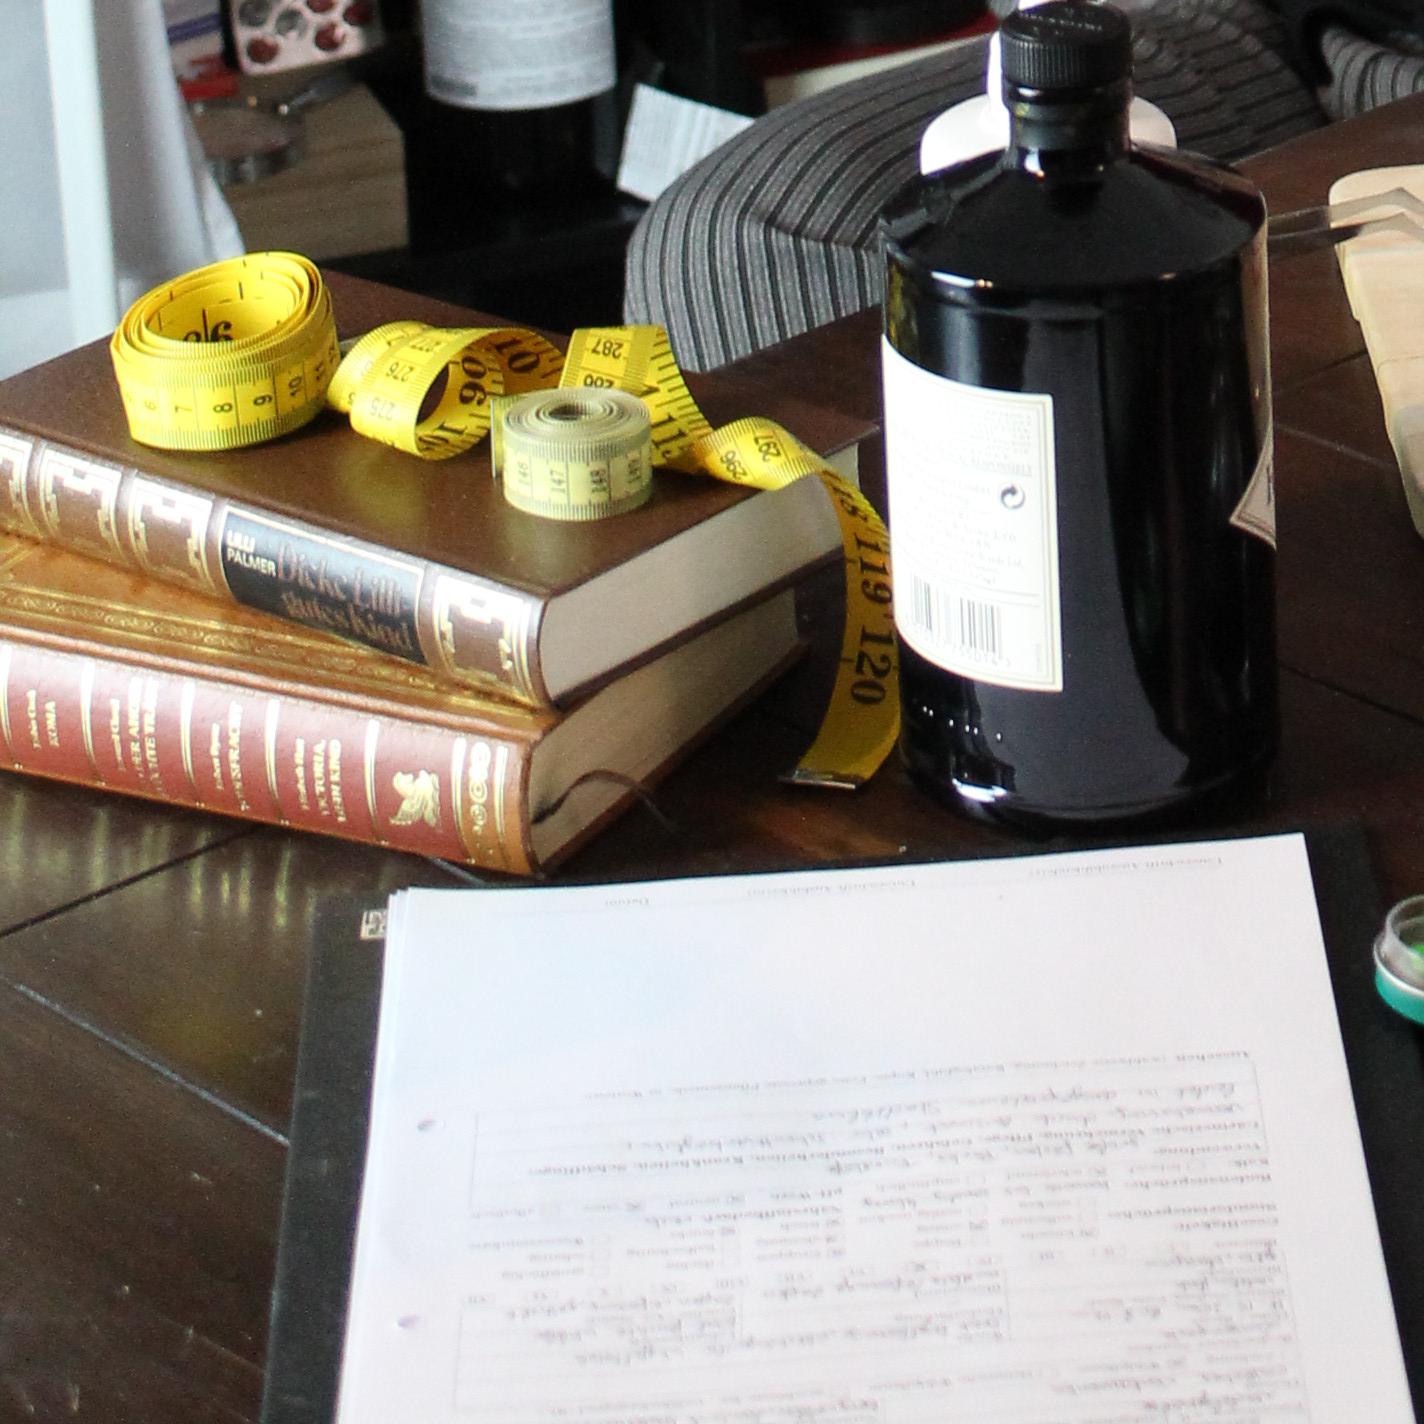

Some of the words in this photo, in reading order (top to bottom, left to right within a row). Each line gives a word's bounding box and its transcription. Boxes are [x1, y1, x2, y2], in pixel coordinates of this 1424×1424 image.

[590, 336, 626, 359] 287
[288, 375, 305, 398] 10
[385, 361, 416, 383] 276
[212, 401, 234, 414] 8
[252, 393, 274, 407] 9
[752, 433, 783, 463] 297
[719, 448, 752, 481] 296
[226, 545, 278, 578] PALMER
[853, 532, 894, 606] 119
[849, 622, 895, 707] 120
[45, 700, 60, 748] KOMA
[328, 738, 343, 782] KIND
